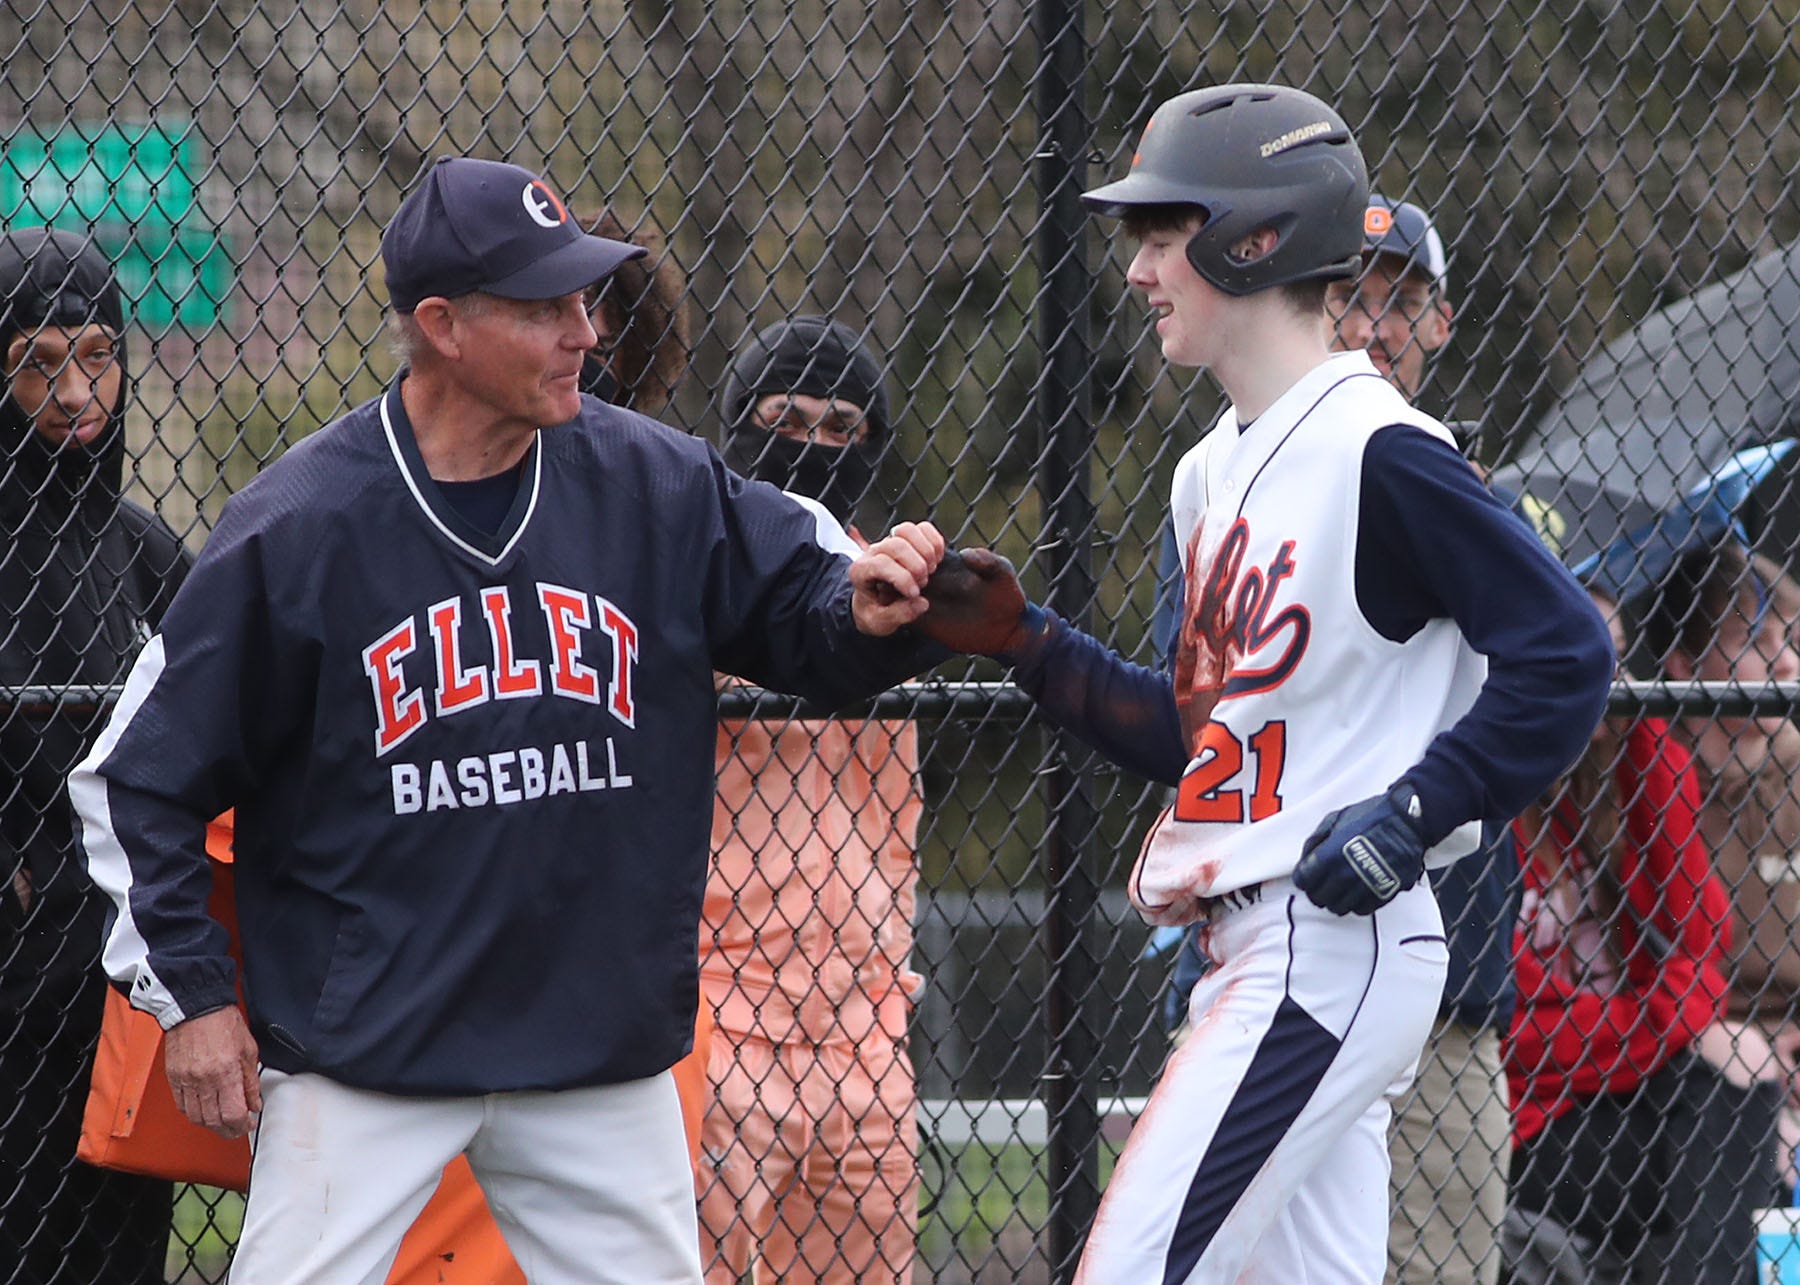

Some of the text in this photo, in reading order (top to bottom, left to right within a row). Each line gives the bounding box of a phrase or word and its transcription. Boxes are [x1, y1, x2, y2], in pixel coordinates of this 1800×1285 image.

[361, 582, 638, 758] ELLET
[391, 737, 633, 815] BASEBALL
[1173, 719, 1286, 824] 21
